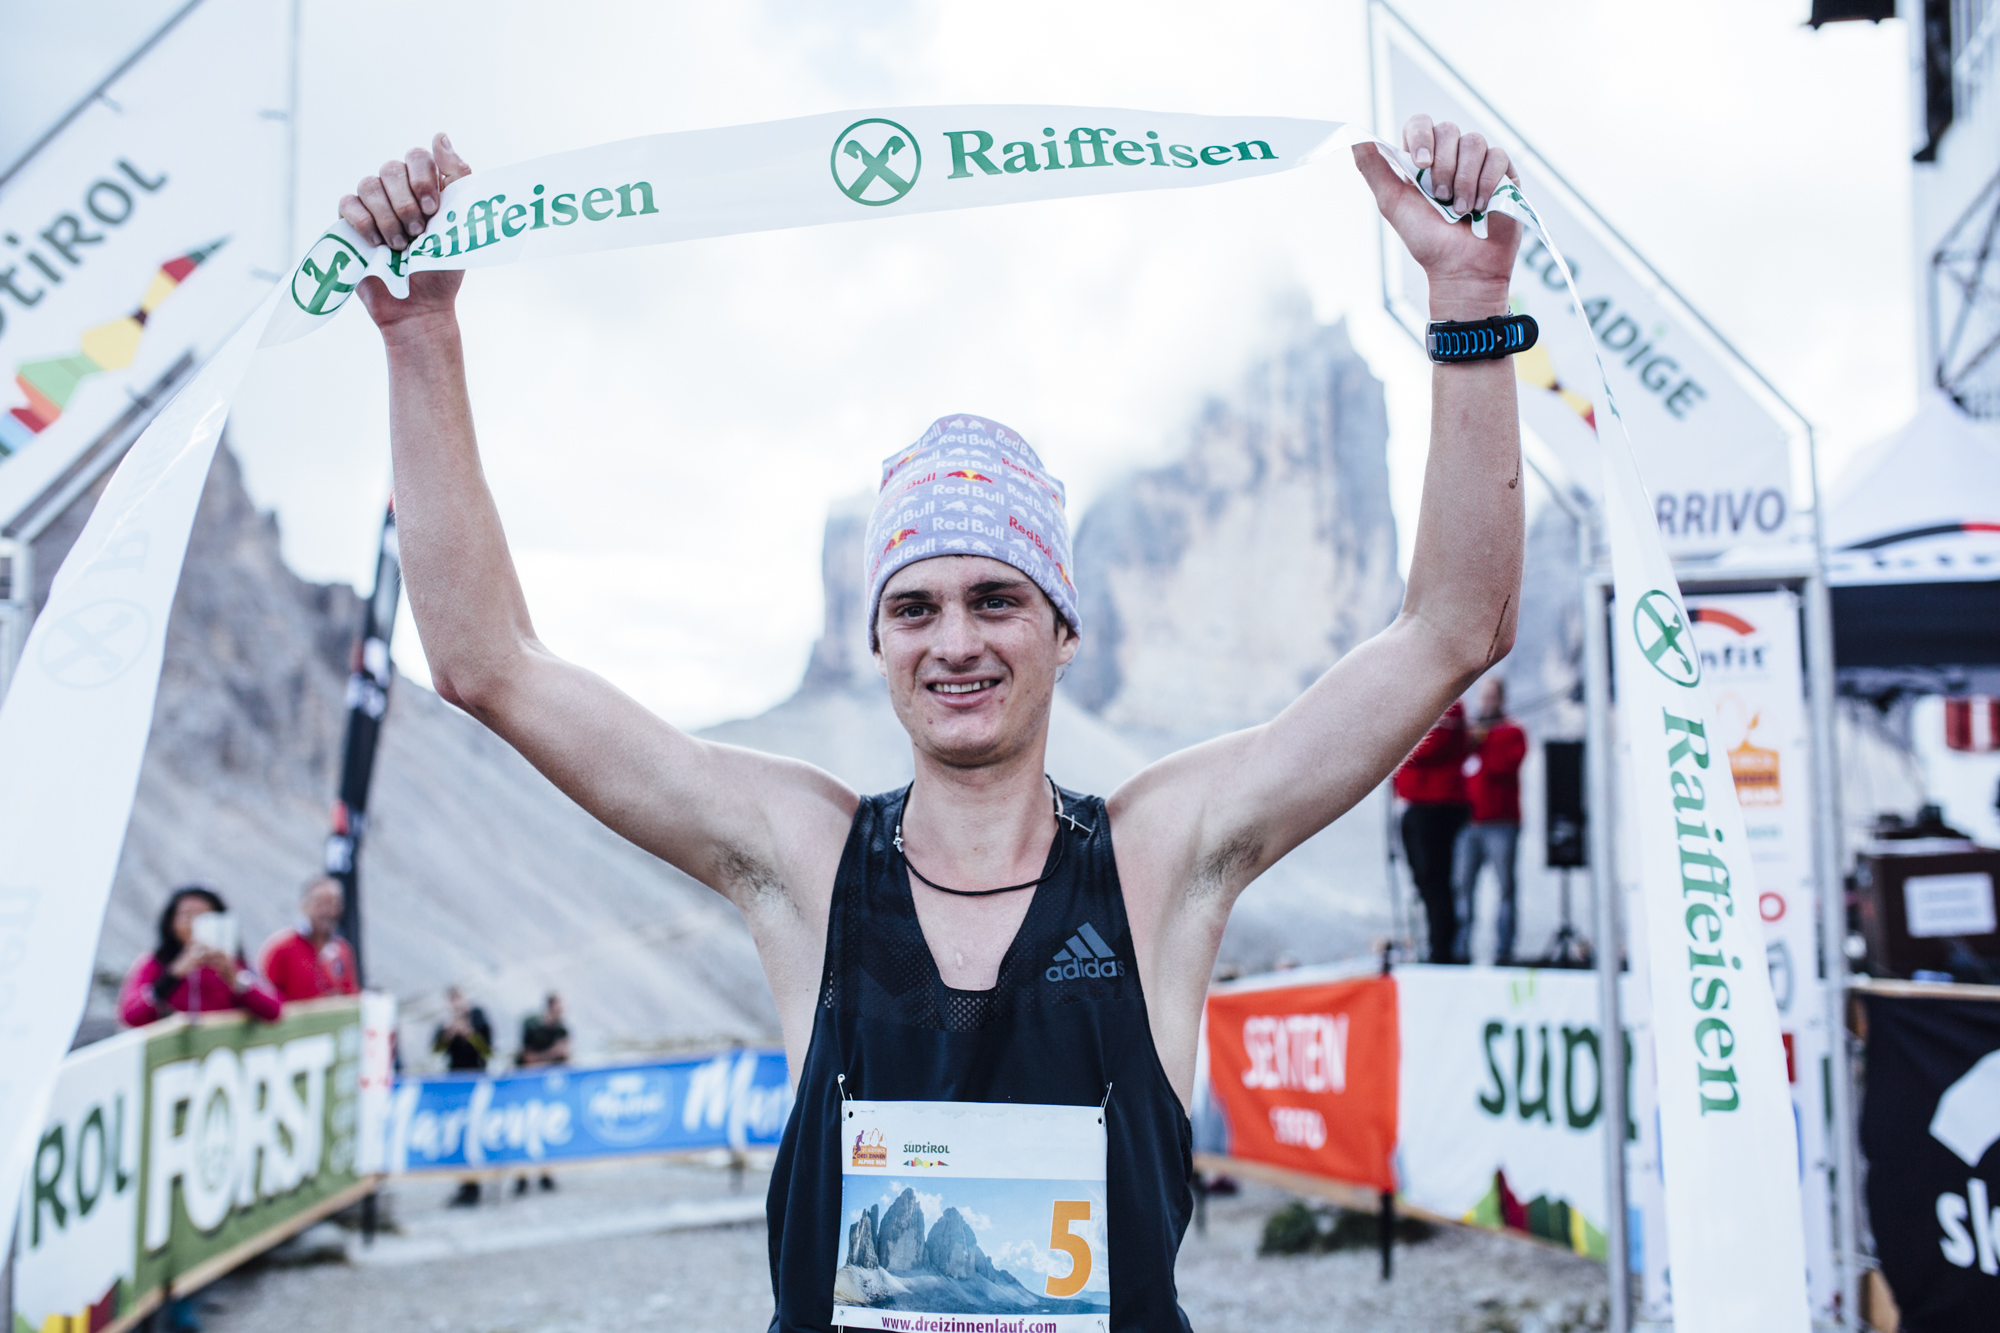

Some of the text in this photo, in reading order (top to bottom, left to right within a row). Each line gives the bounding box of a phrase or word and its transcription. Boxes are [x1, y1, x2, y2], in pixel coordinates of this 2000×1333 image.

[943, 127, 1279, 179] Raiffeisen
[938, 433, 967, 445] Red
[996, 428, 1021, 452] Red
[936, 459, 1003, 475] Red Bull
[932, 484, 1005, 506] Red Bull
[1007, 482, 1034, 507] Red
[903, 500, 935, 523] Bull
[1655, 489, 1785, 534] RRIVO
[932, 517, 1004, 541] Red Bull
[1009, 514, 1034, 541] Red
[1034, 533, 1053, 561] Bull
[903, 538, 936, 560] Bull
[1662, 706, 1742, 1116] Raiffeisen
[1045, 957, 1126, 982] adidas
[144, 1033, 334, 1250] FORST
[1045, 1200, 1092, 1297] 5
[881, 1315, 1057, 1333] www.dreizinnenlauf.com
